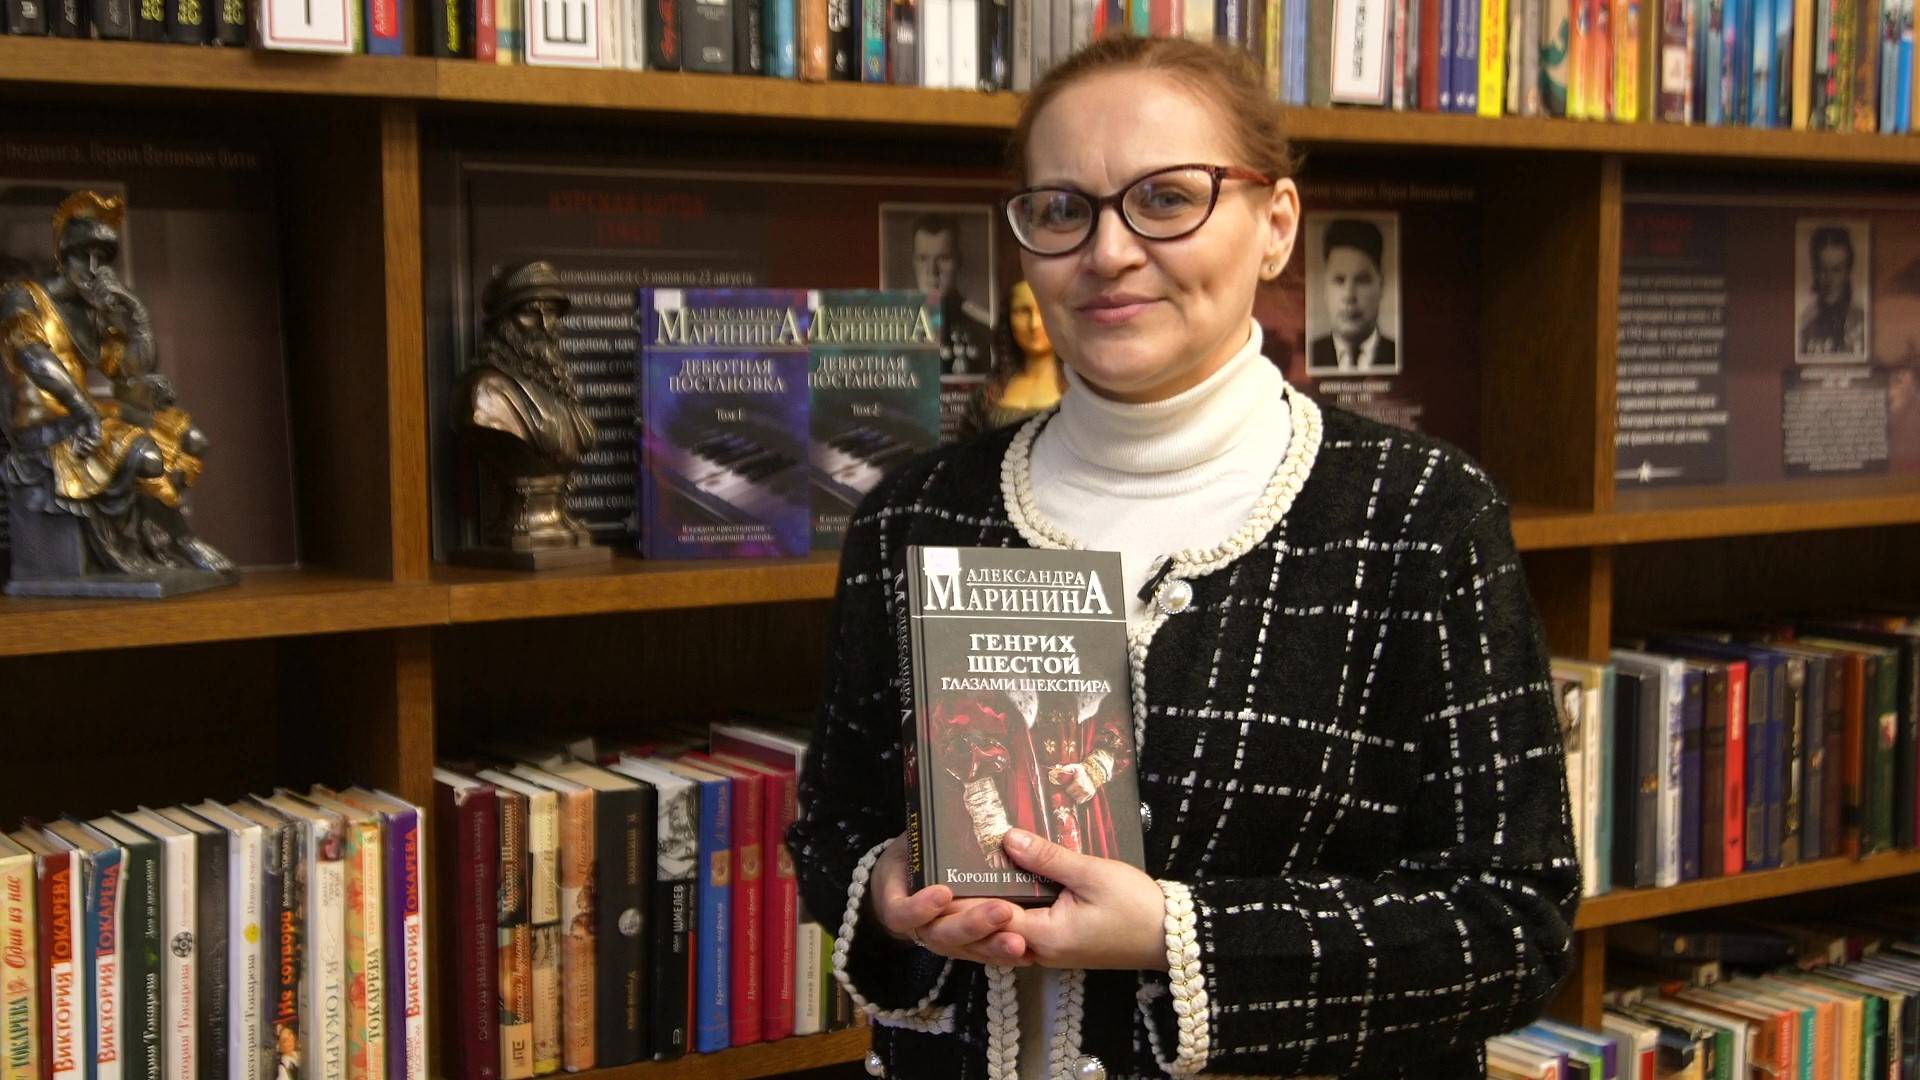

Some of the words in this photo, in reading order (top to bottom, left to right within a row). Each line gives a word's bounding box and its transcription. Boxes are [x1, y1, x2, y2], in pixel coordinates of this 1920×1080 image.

[560, 271, 632, 283] олжавшаяся
[698, 270, 711, 283] 23
[656, 308, 802, 346] МАРИНИНА
[690, 308, 781, 321] АЛЕКСАНДРА
[826, 308, 915, 320] АЛЕКСАНДРА
[615, 338, 635, 350] нач
[669, 375, 786, 393] ПОСТАНОВКА
[679, 360, 772, 377] ДЕБЮТНАЯ
[817, 356, 906, 373] ДЕБЮТНАЯ
[586, 384, 632, 398] перехва
[592, 472, 633, 485] массов
[923, 567, 1113, 615] МАРИНИНА
[966, 568, 1086, 588] АЛЕКСАНДРА
[969, 633, 1076, 653] ГЕНРИХ
[967, 652, 1081, 675] ШЕСТОЙ
[941, 677, 1017, 691] ГЛАЗАМИ
[1020, 678, 1112, 693] ШЕКСПИРА
[501, 804, 514, 862] Шишкин
[910, 811, 920, 874] ГЕНРИХ
[6, 875, 21, 901] нас
[403, 828, 418, 921] ТОКАРЕВА
[502, 863, 519, 912] Михаил
[9, 908, 22, 923] из
[51, 869, 70, 967] ТОКАРЕВА
[95, 863, 121, 959] ТОКАРЕВА
[672, 884, 684, 932] ШМЕЛЕВ
[2, 928, 26, 968] Один
[280, 911, 296, 985] сотвори
[244, 954, 258, 1022] Токарева
[405, 924, 420, 1018] ВИКТОРИЯ
[96, 963, 117, 1064] ВИКТОРИЯ
[142, 972, 159, 1044] Токарева
[176, 964, 191, 1032] Токарева
[277, 990, 293, 1017] Не
[367, 948, 382, 1042] ТОКАРЕВА
[8, 997, 30, 1069] ТОКАРЕВА
[53, 972, 75, 1073] ВИКТОРИЯ
